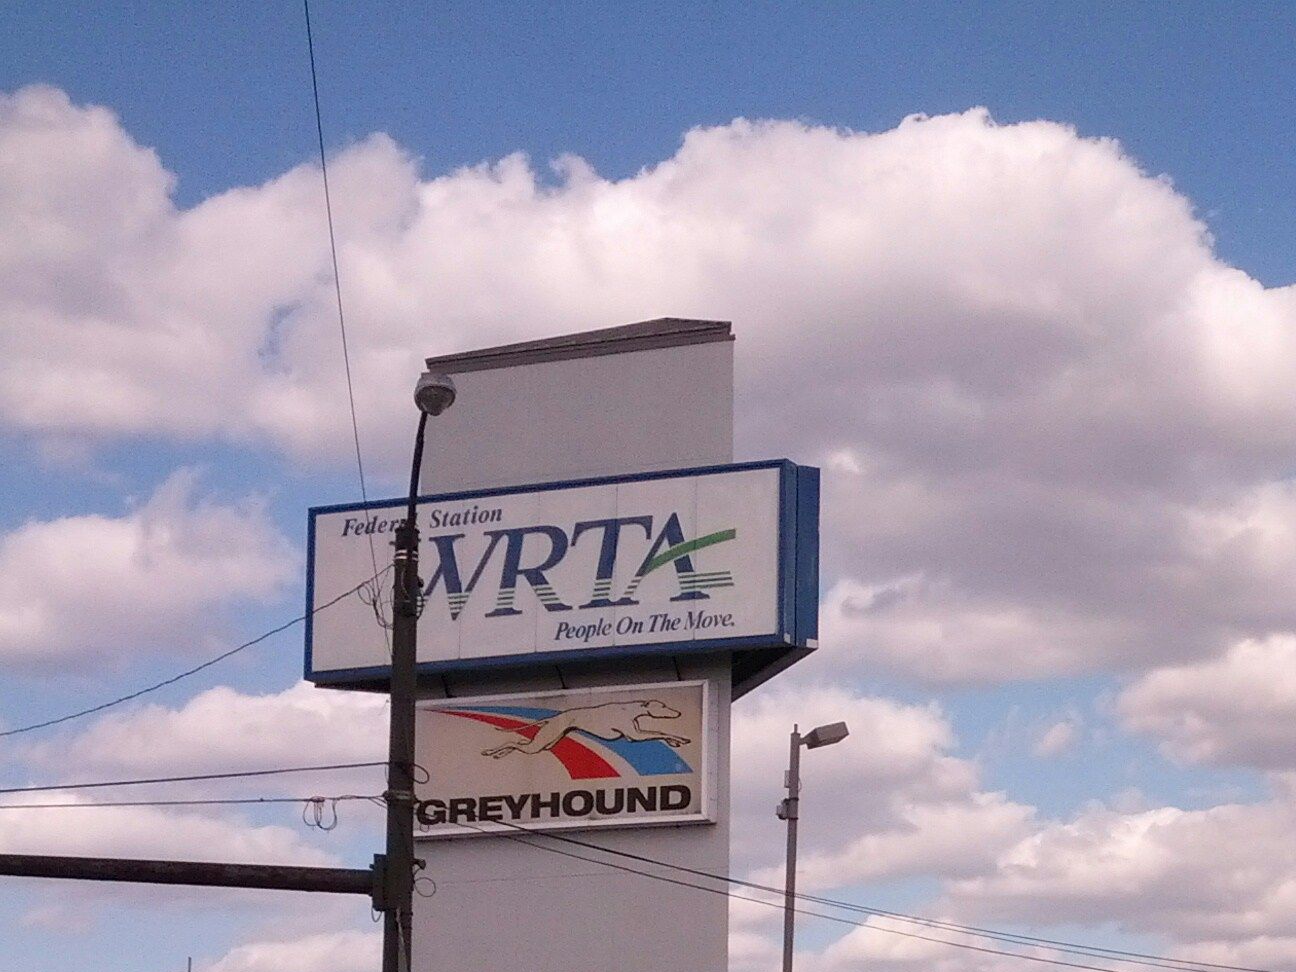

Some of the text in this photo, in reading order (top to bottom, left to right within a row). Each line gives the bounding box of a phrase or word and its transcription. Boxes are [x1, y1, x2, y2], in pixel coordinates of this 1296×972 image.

[341, 505, 503, 537] Federa Station
[417, 511, 736, 621] WRTA
[554, 610, 736, 643] People On The Move.
[416, 784, 692, 827] GREYHOUND
